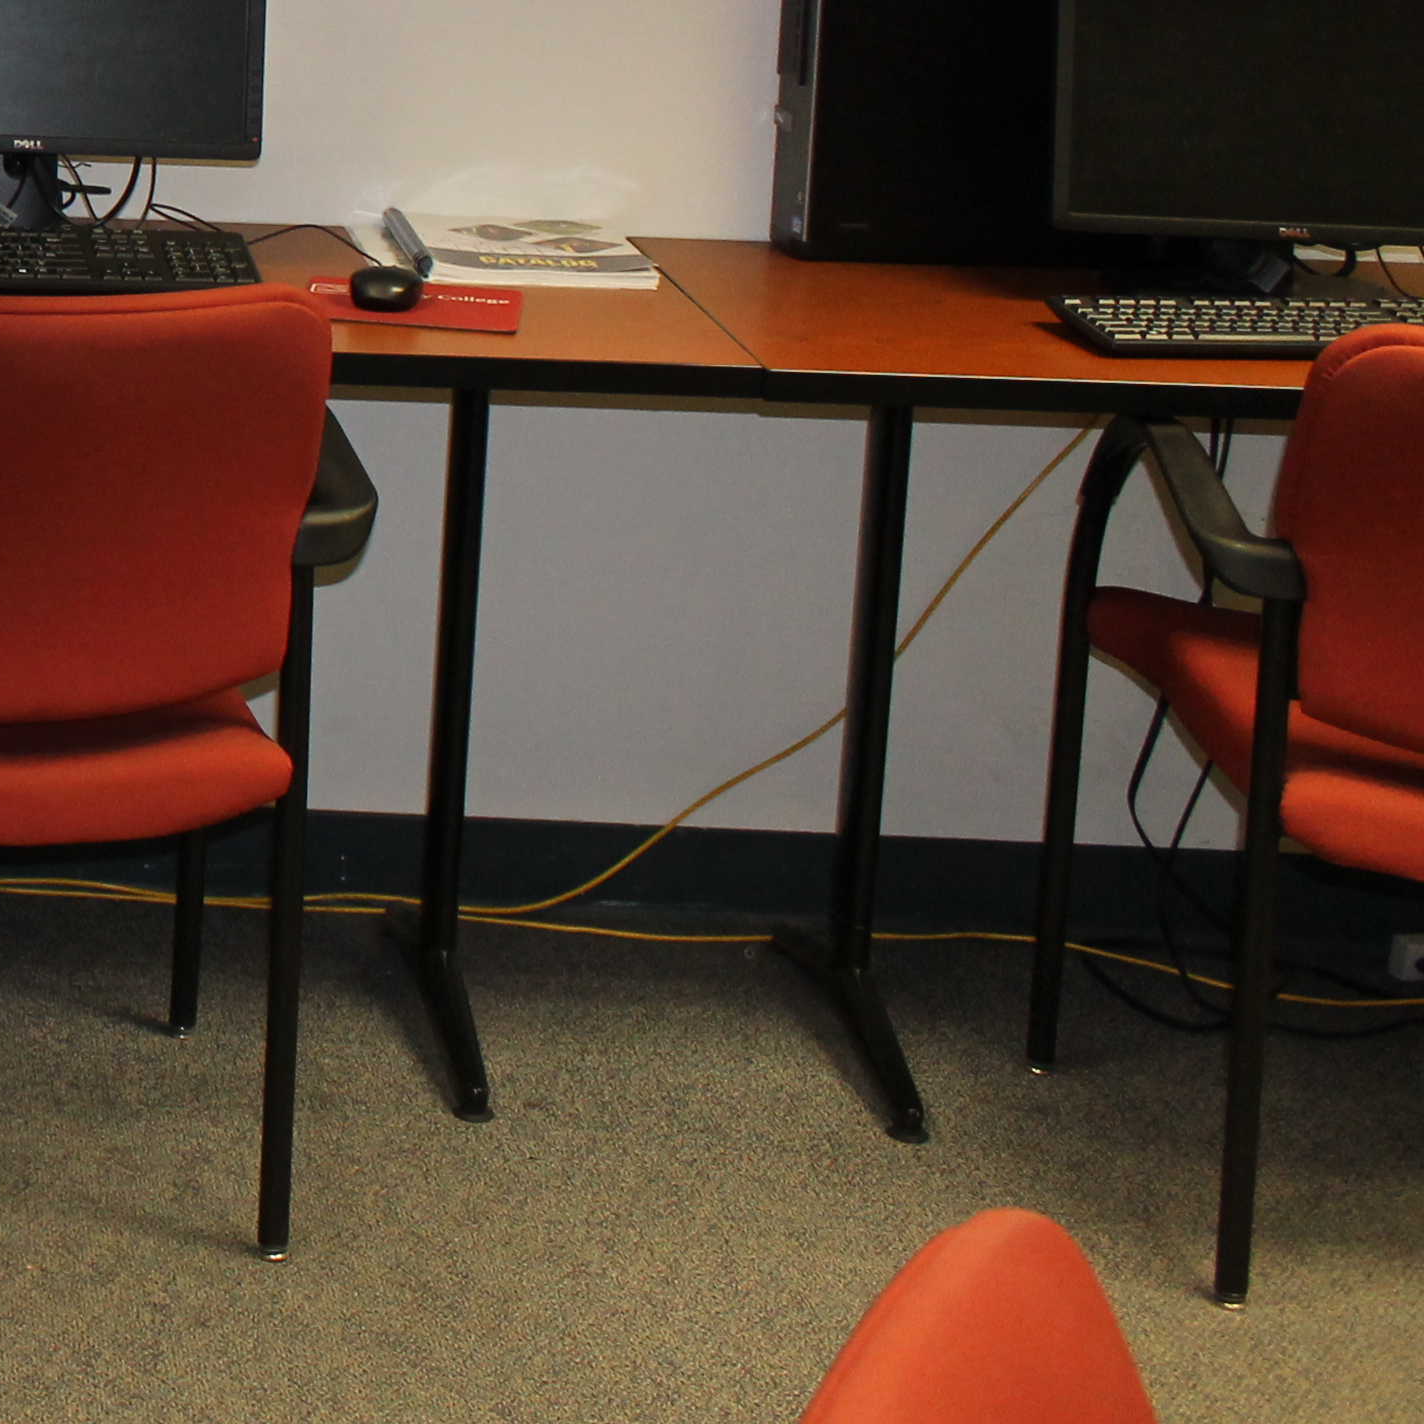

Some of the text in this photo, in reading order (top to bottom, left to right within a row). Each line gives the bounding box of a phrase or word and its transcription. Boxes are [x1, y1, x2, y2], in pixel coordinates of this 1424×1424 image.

[13, 139, 44, 150] DELL
[478, 254, 599, 269] CATALOG
[437, 294, 510, 306] College
